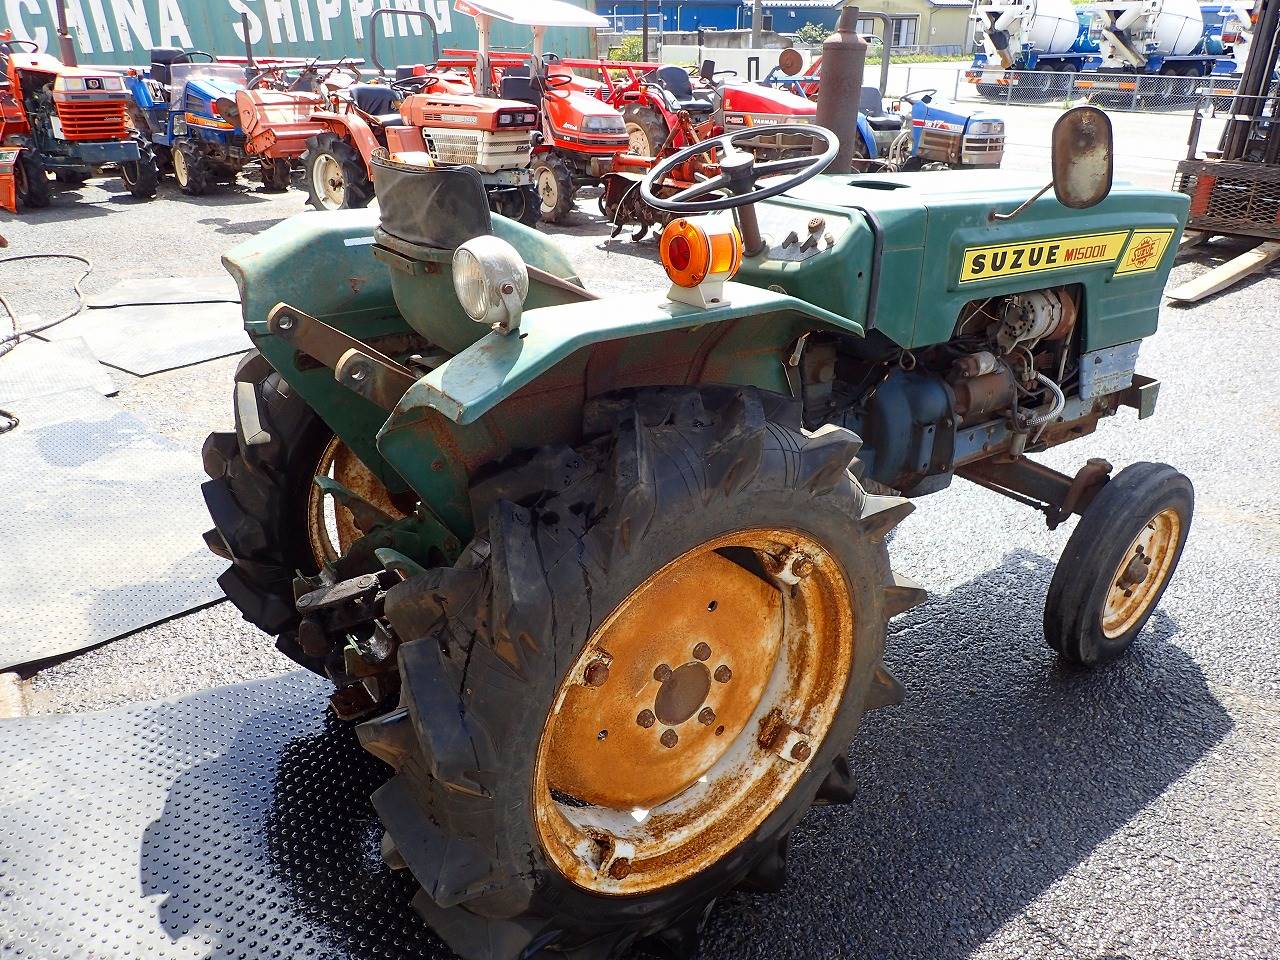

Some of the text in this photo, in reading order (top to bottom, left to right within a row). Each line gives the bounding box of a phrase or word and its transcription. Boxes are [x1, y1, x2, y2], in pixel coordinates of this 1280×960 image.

[5, 0, 452, 54] CHINA SHIPPING
[971, 244, 1060, 275] SUZUE
